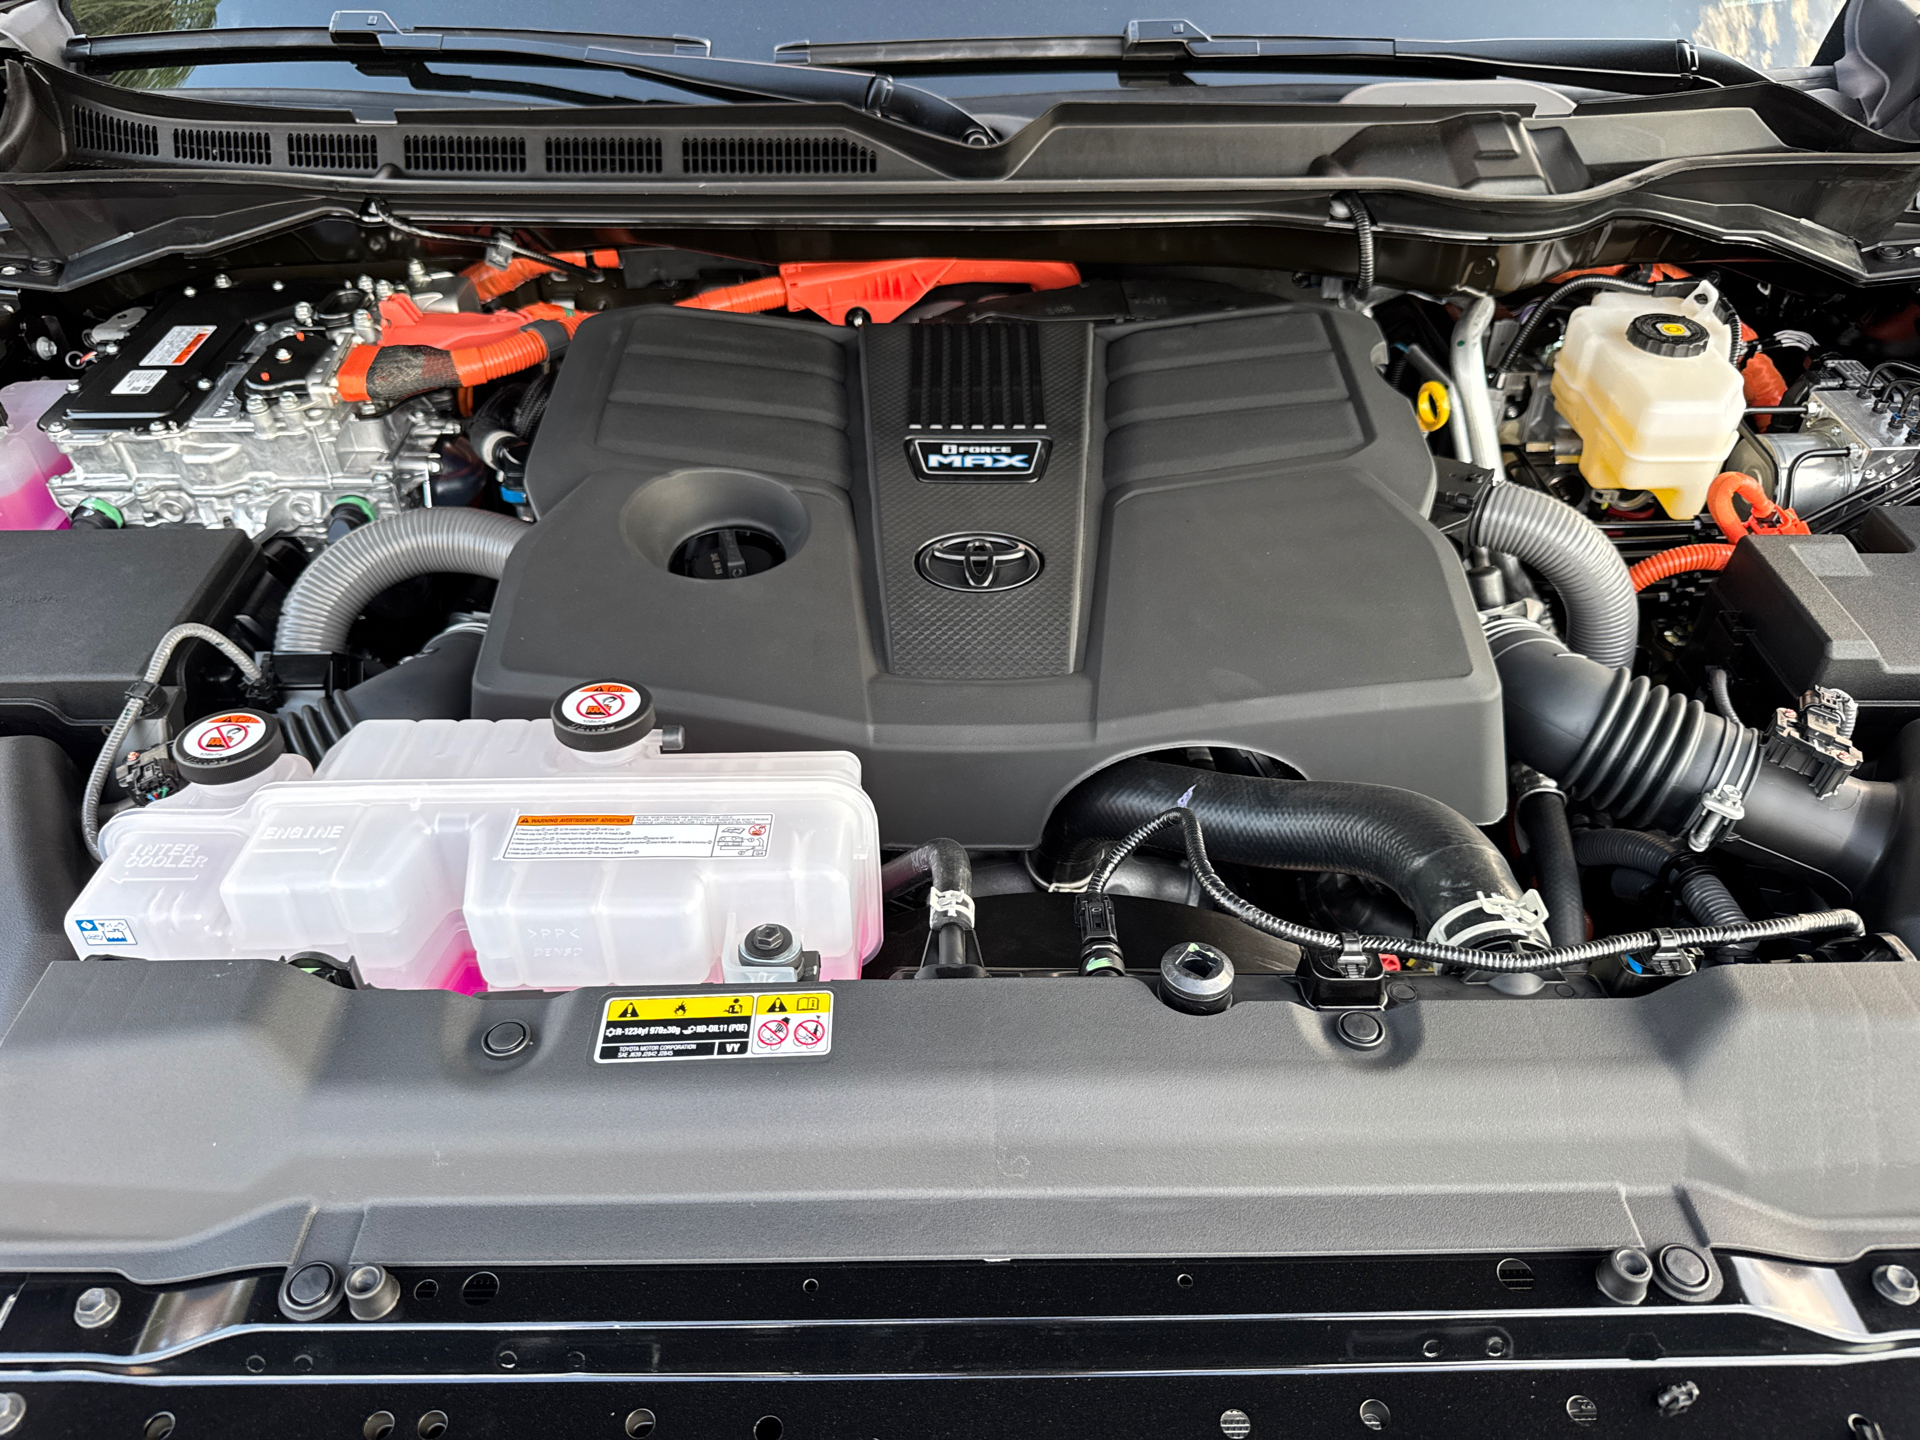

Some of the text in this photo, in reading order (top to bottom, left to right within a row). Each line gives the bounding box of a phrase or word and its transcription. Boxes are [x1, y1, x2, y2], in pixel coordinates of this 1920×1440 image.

[928, 454, 1029, 467] MAX
[261, 825, 344, 841] ENGINE
[130, 843, 199, 856] INTER
[124, 855, 208, 868] COOLER
[534, 947, 583, 957] DENSO
[725, 1043, 741, 1053] VY
